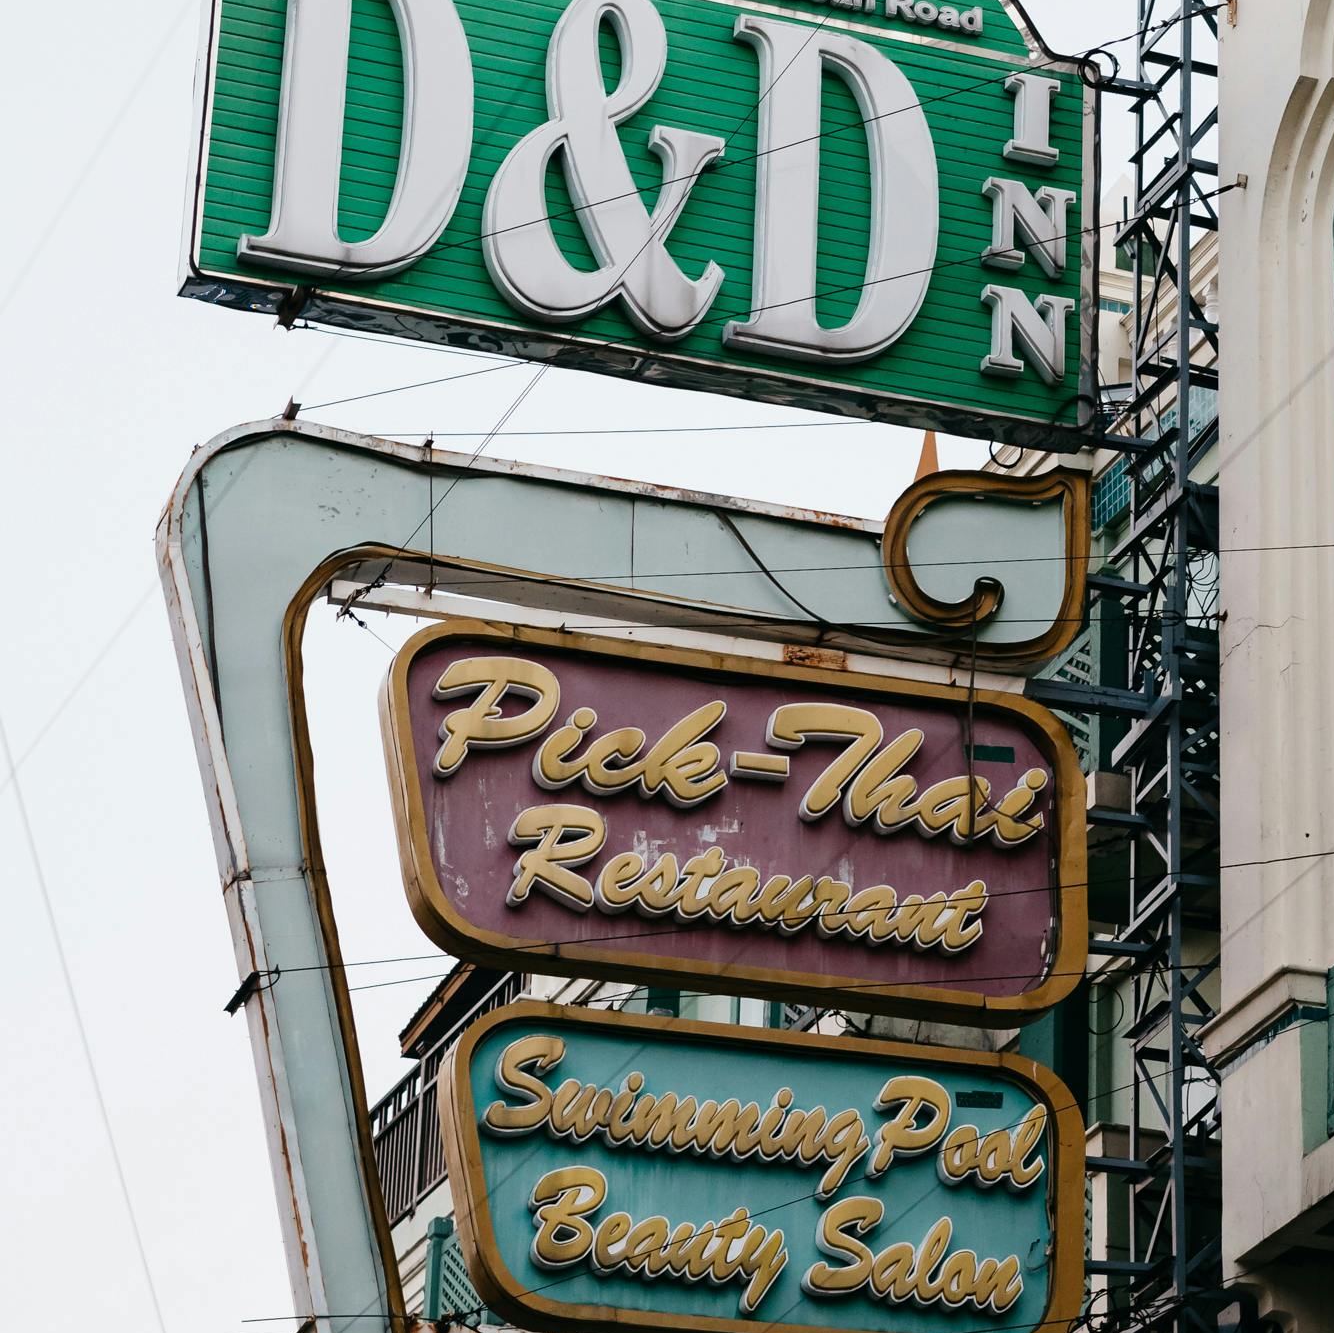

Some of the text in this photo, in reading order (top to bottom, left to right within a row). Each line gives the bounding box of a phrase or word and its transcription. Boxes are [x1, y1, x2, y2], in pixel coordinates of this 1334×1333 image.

[980, 71, 1077, 386] INN
[432, 656, 1050, 849] Pick-Thai
[505, 803, 989, 957] Restaurant
[481, 1035, 1047, 1200] Swimming Pool
[529, 1166, 1024, 1315] Beauty Salon
